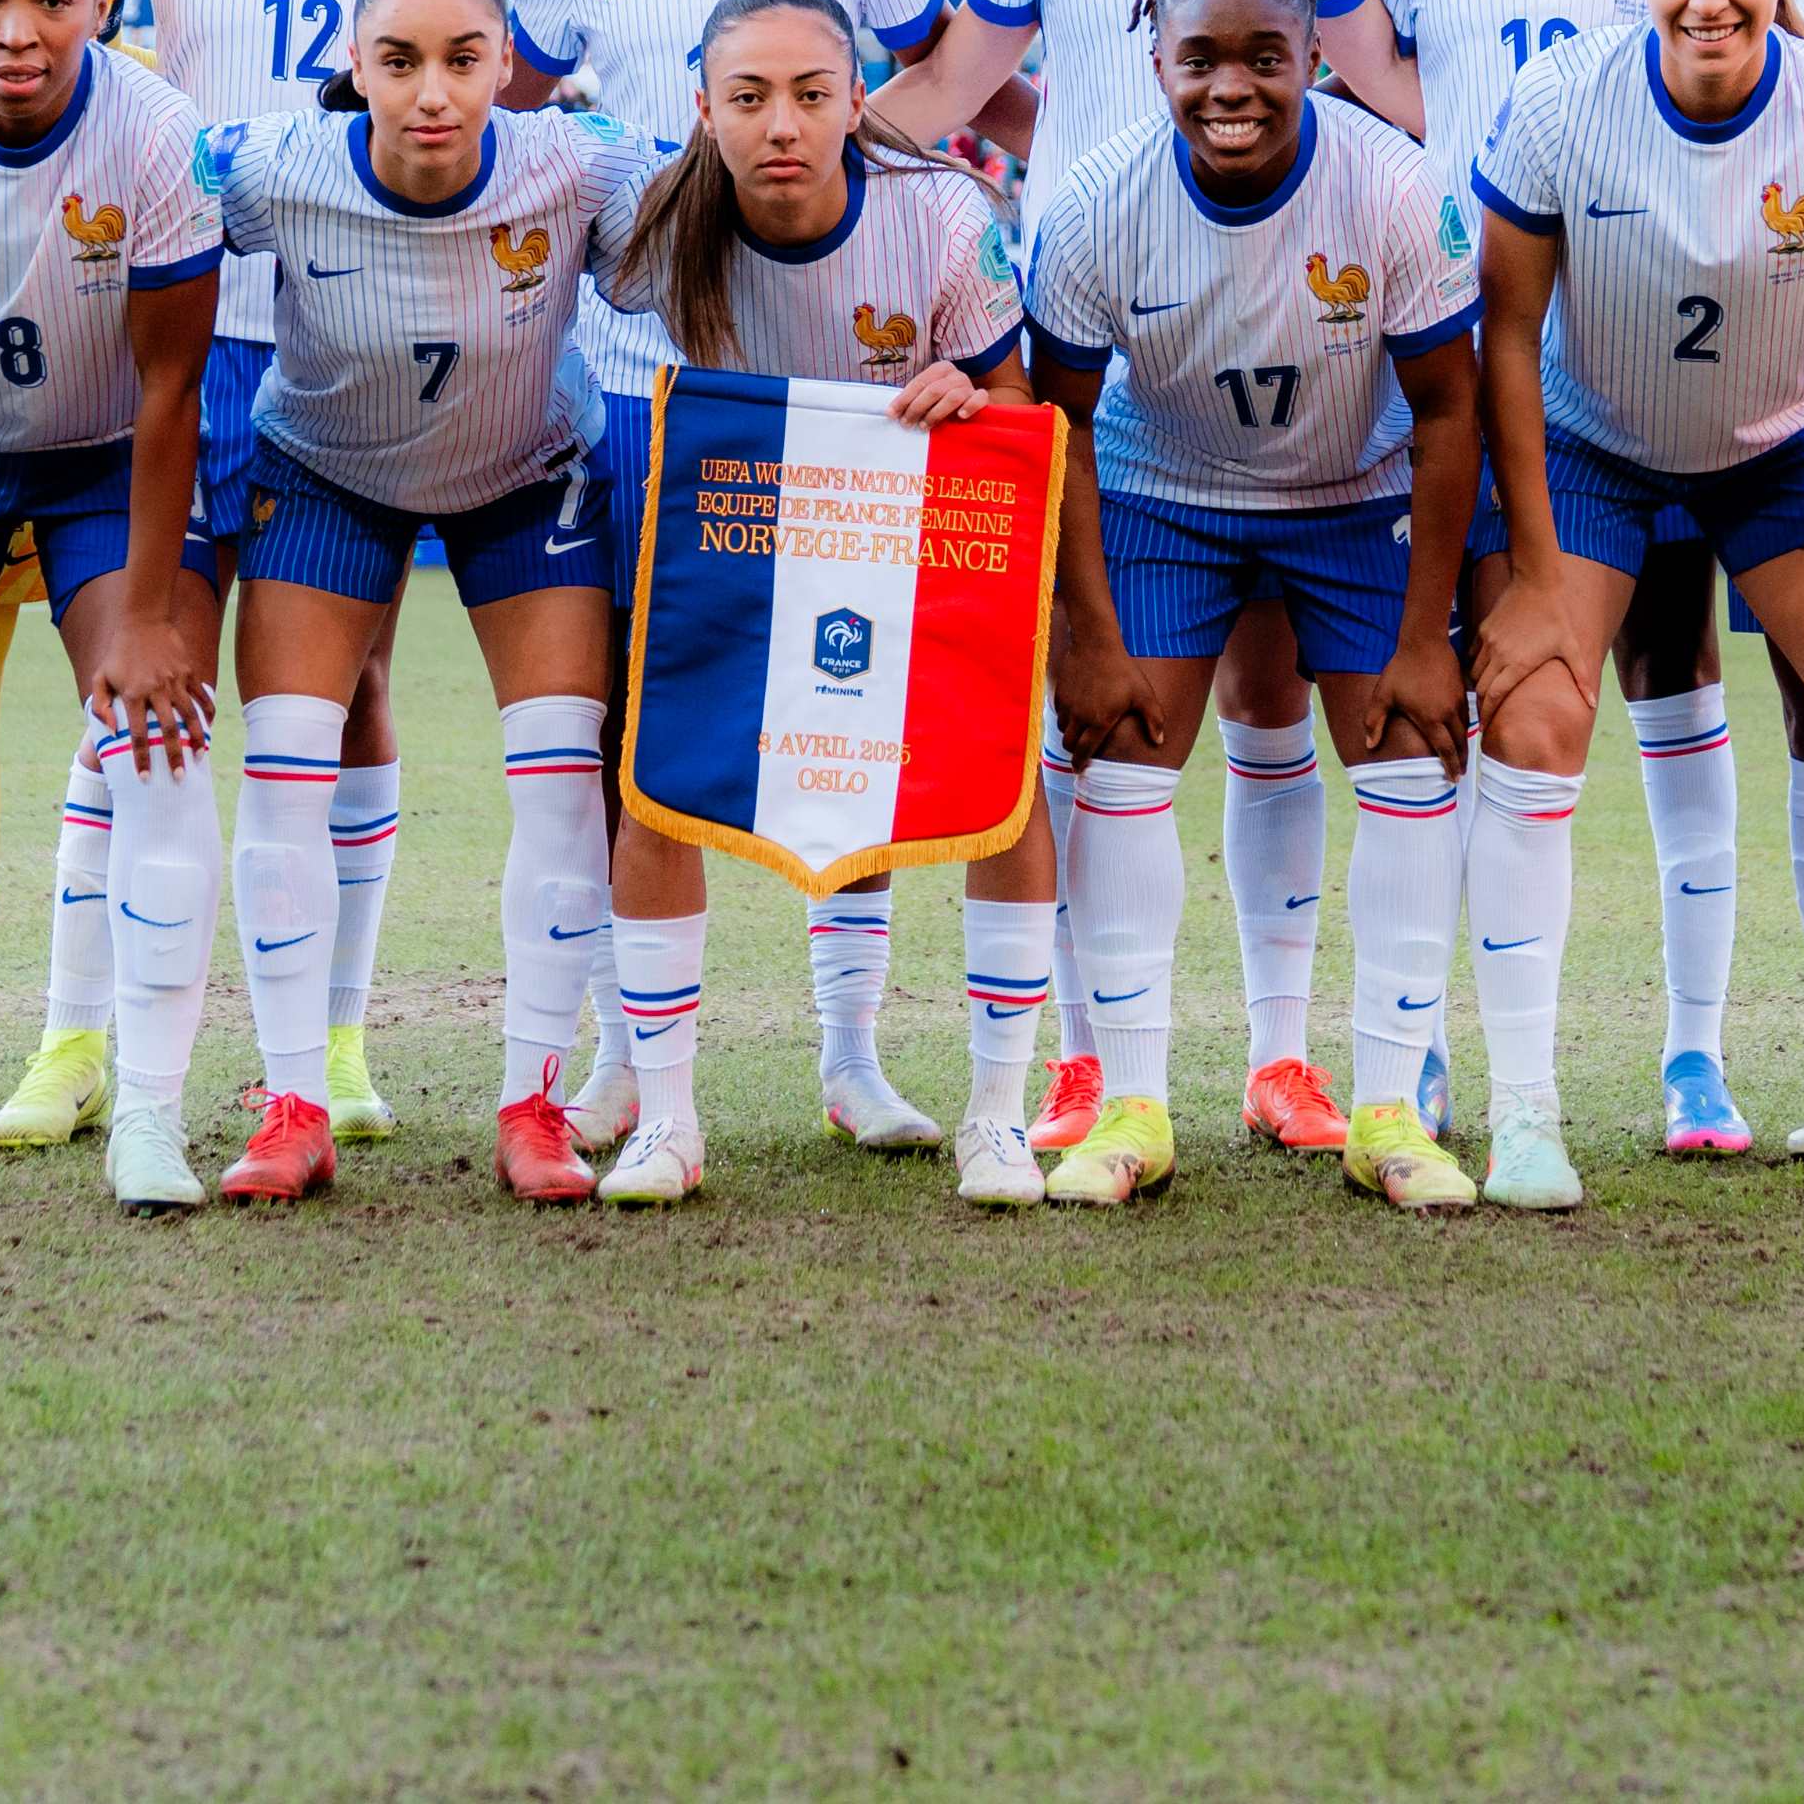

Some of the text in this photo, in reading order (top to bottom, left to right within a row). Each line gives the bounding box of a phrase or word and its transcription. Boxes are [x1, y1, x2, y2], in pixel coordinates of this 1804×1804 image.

[1673, 295, 1724, 364] 2
[413, 342, 460, 403] 7
[1214, 364, 1301, 428] 17
[546, 462, 590, 530] 7
[700, 459, 1017, 505] UEFA WOMEN'S NATIONS LEAGUE
[696, 491, 1013, 537] EQUIPE DE FRANCE FEMININE
[699, 521, 1010, 574] NORVEGE-FRANCE
[821, 657, 862, 669] FRANCE
[815, 685, 864, 698] FÉMININE
[758, 732, 911, 765] 8 AVRIL 2025
[798, 767, 869, 794] OSLO
